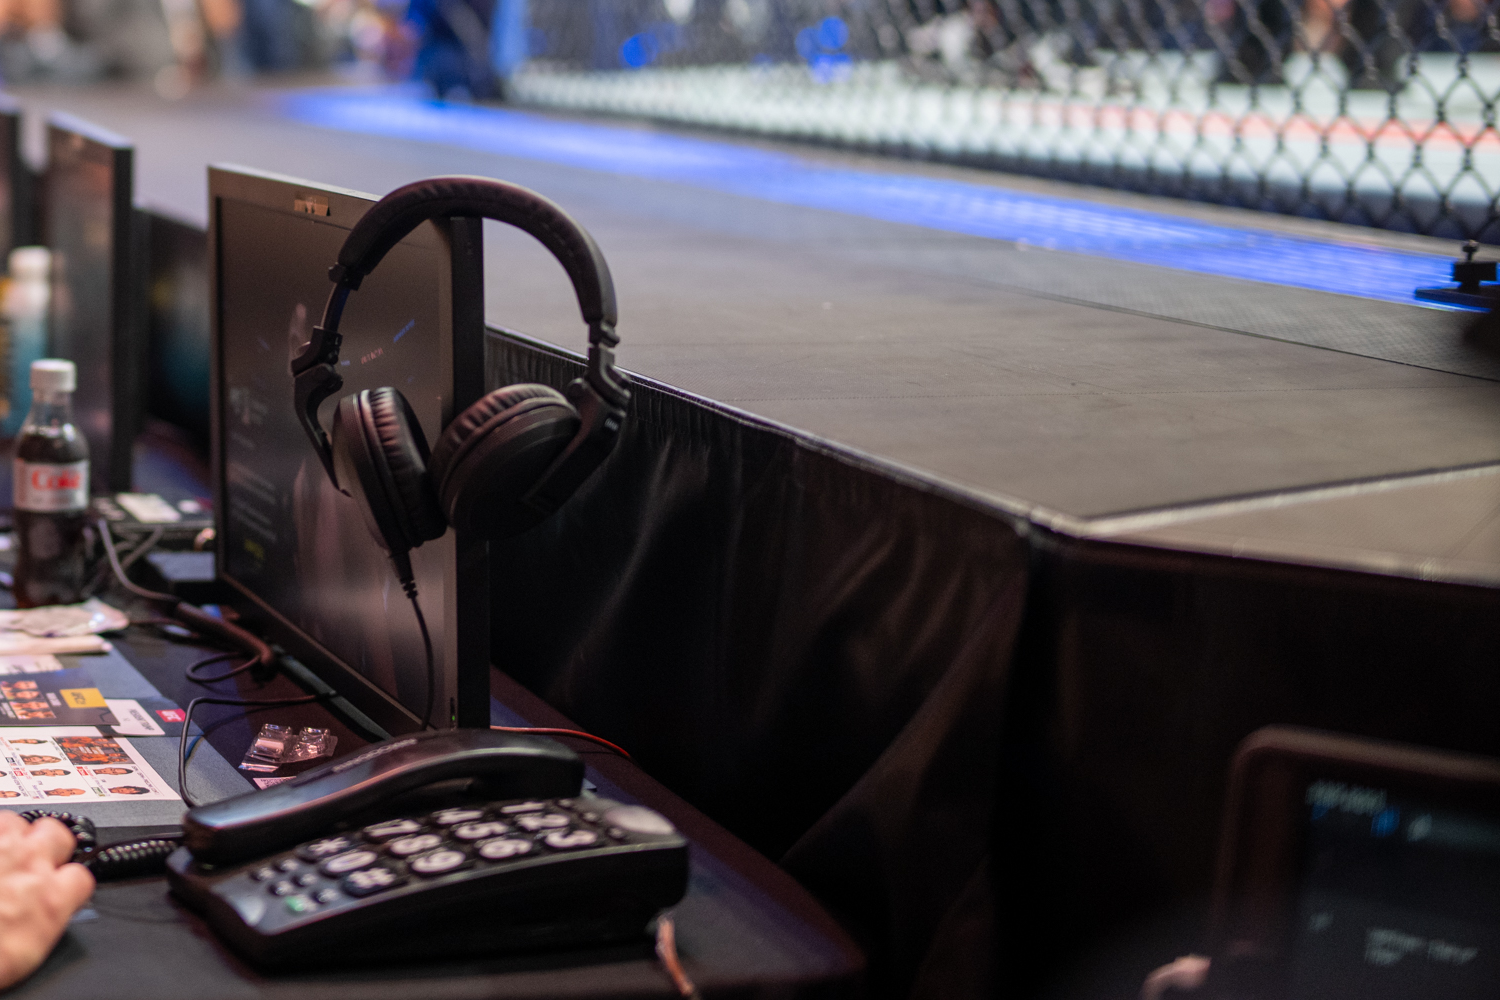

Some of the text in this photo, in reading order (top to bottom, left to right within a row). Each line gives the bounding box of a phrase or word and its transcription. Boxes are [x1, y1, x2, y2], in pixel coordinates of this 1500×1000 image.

[479, 839, 532, 859] 6
[545, 829, 597, 848] 3
[326, 851, 377, 873] 0
[412, 850, 465, 873] 9
